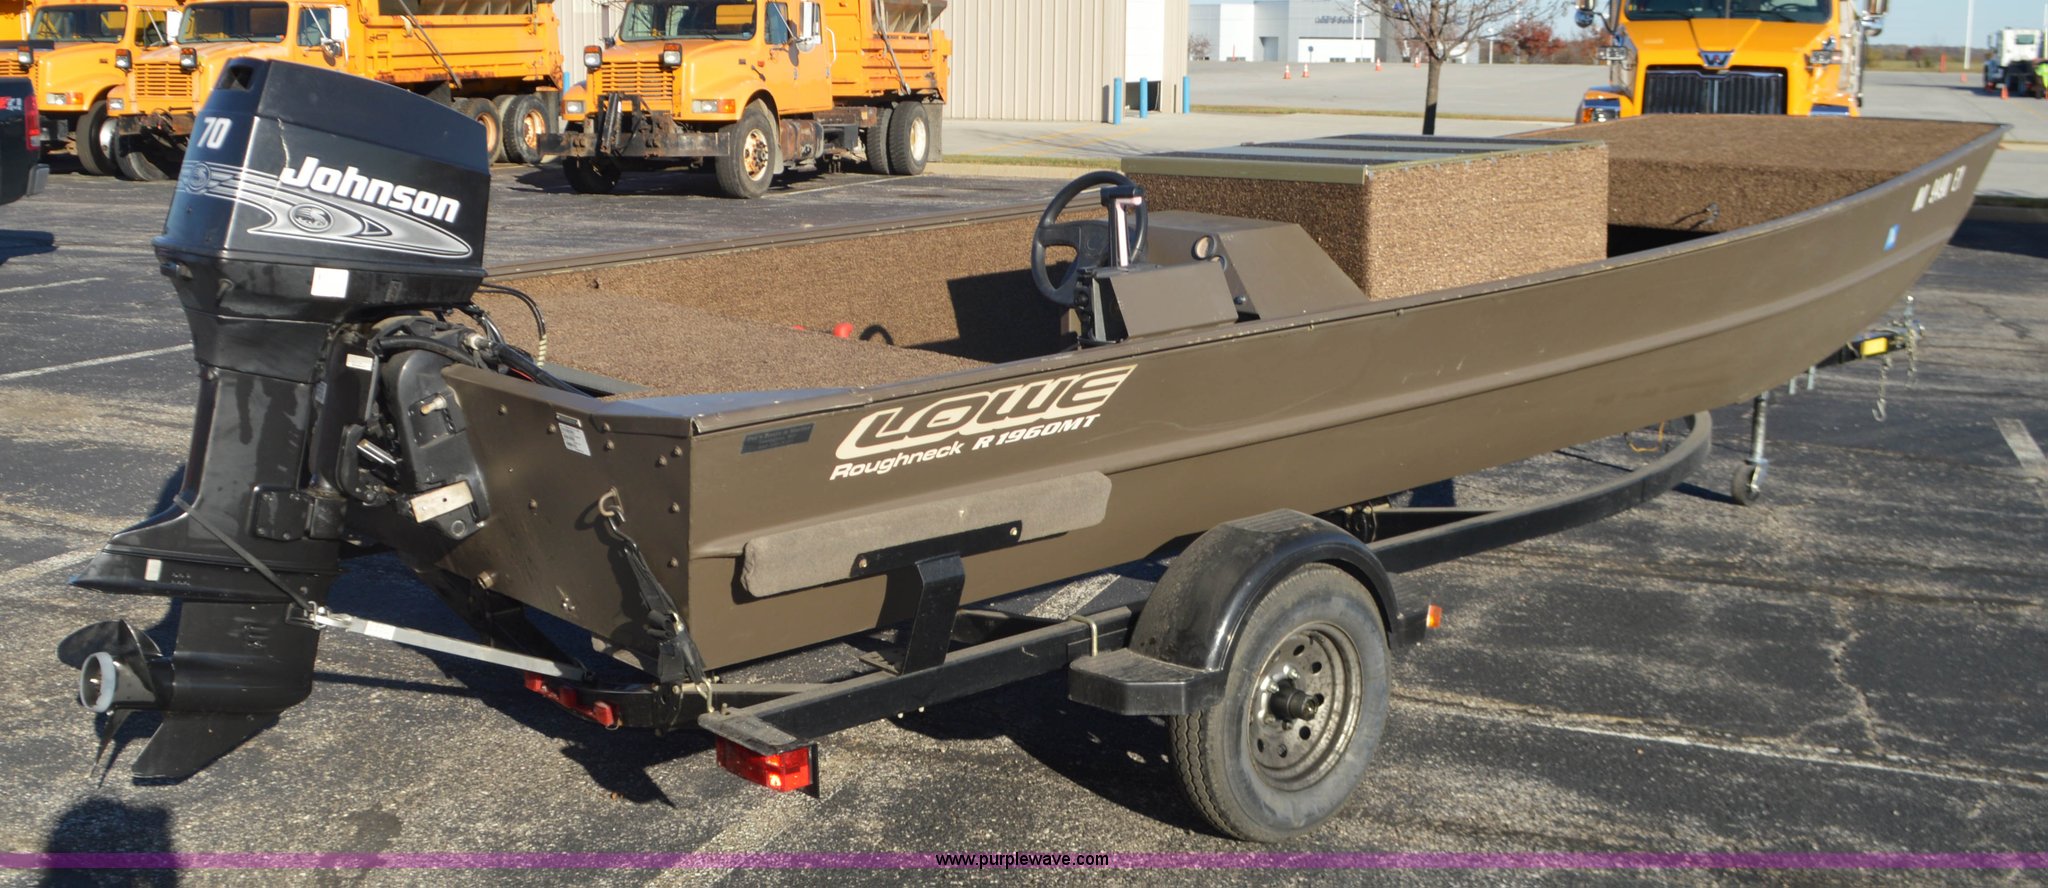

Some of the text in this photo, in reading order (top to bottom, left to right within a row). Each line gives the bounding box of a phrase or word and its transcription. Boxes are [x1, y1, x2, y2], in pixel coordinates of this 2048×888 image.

[197, 117, 232, 149] 70
[280, 156, 462, 223] Johnson
[835, 363, 1139, 460] LOWE
[829, 441, 965, 480] Roughneck
